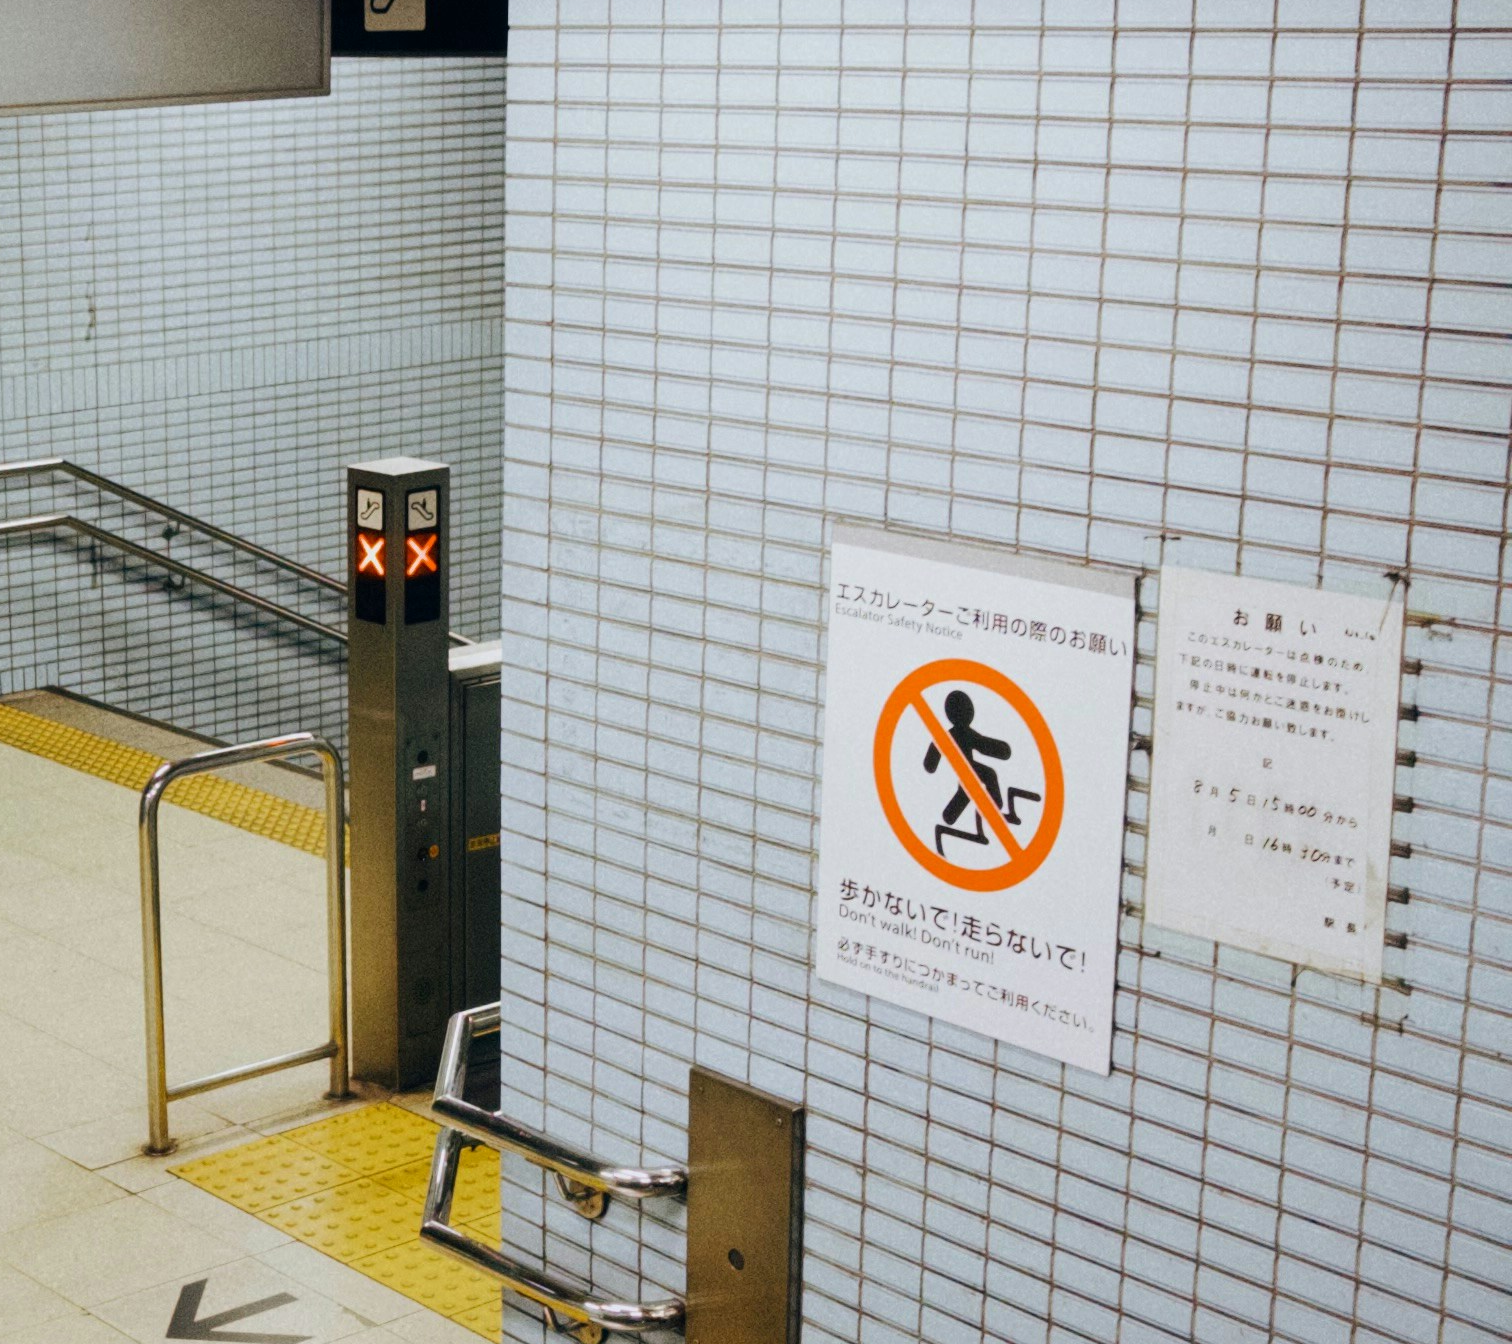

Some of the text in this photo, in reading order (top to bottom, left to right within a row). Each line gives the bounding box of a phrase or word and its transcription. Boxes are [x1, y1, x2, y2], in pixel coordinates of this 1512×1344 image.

[835, 582, 1128, 657] エスカレーターご利用の際のお願い
[835, 603, 964, 641] Escalator Safety Notice
[1233, 608, 1318, 636] お願い
[838, 903, 995, 966] Don't walk! Don't run!
[839, 877, 1088, 973] 歩かないで!走らないで!
[836, 953, 939, 993] Hold on to the handrail
[836, 937, 1095, 1034] 必ず手すりにつかまってご利用ください。
